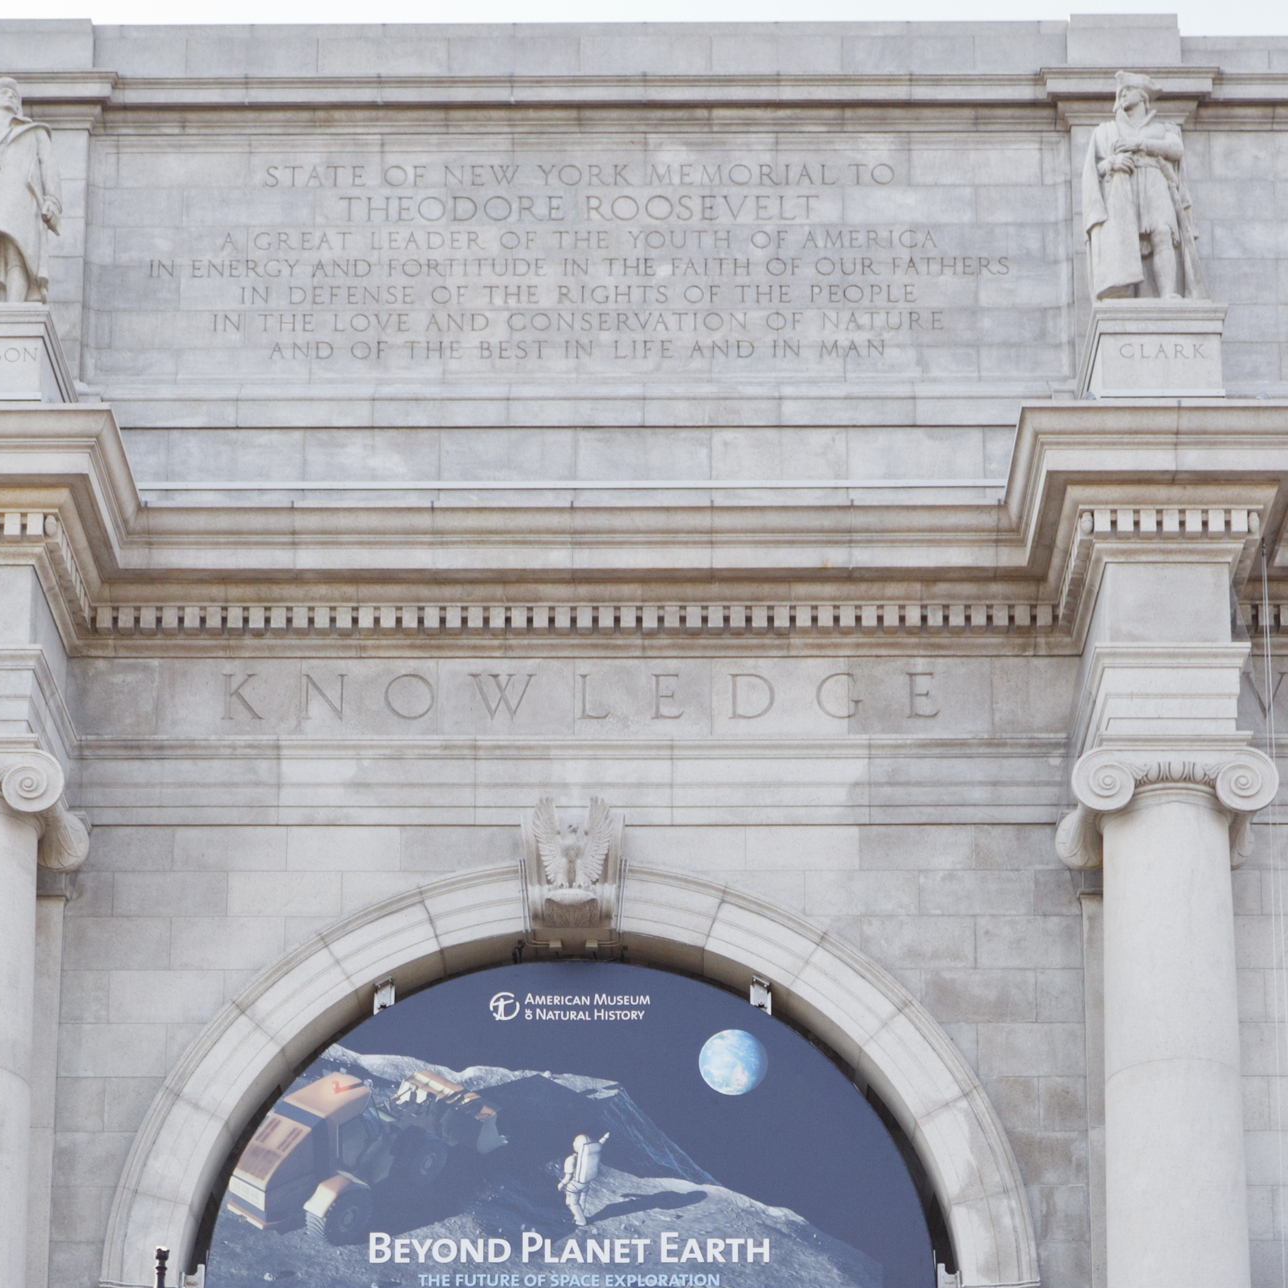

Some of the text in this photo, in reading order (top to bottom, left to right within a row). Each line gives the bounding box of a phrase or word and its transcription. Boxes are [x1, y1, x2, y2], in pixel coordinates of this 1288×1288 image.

[264, 164, 895, 188] STATE OF NEW YORK MEMORIAL TO
[338, 195, 820, 223] THEODORE ROOSEVELT
[220, 230, 939, 250] A GREAT LEADER OF THE YOUTH OF AMERICA
[148, 258, 1010, 278] IN ENERGY AND FORTITUDE IN THE FAITH OF OUR FATHERS
[240, 285, 918, 305] IN DEFENSE OF THE RIGHTS OF THE PEOPLE
[212, 312, 945, 332] IN THE LOVE AND CONSERVATION OF NATURE
[269, 340, 886, 360] AND OF THE BEST IN LIFE AND IN MAN
[1119, 343, 1208, 359] CLARK
[222, 672, 941, 722] KNOWLEDGE
[524, 993, 651, 1006] AMERICAN MUSEUM
[536, 1008, 591, 1021] NATURAL
[594, 1008, 645, 1021] HISTORY
[368, 1231, 771, 1264] BEYOND PLANET EARTH
[418, 1274, 721, 1288] THE FUTURE OF SPACE EXPLORATION
